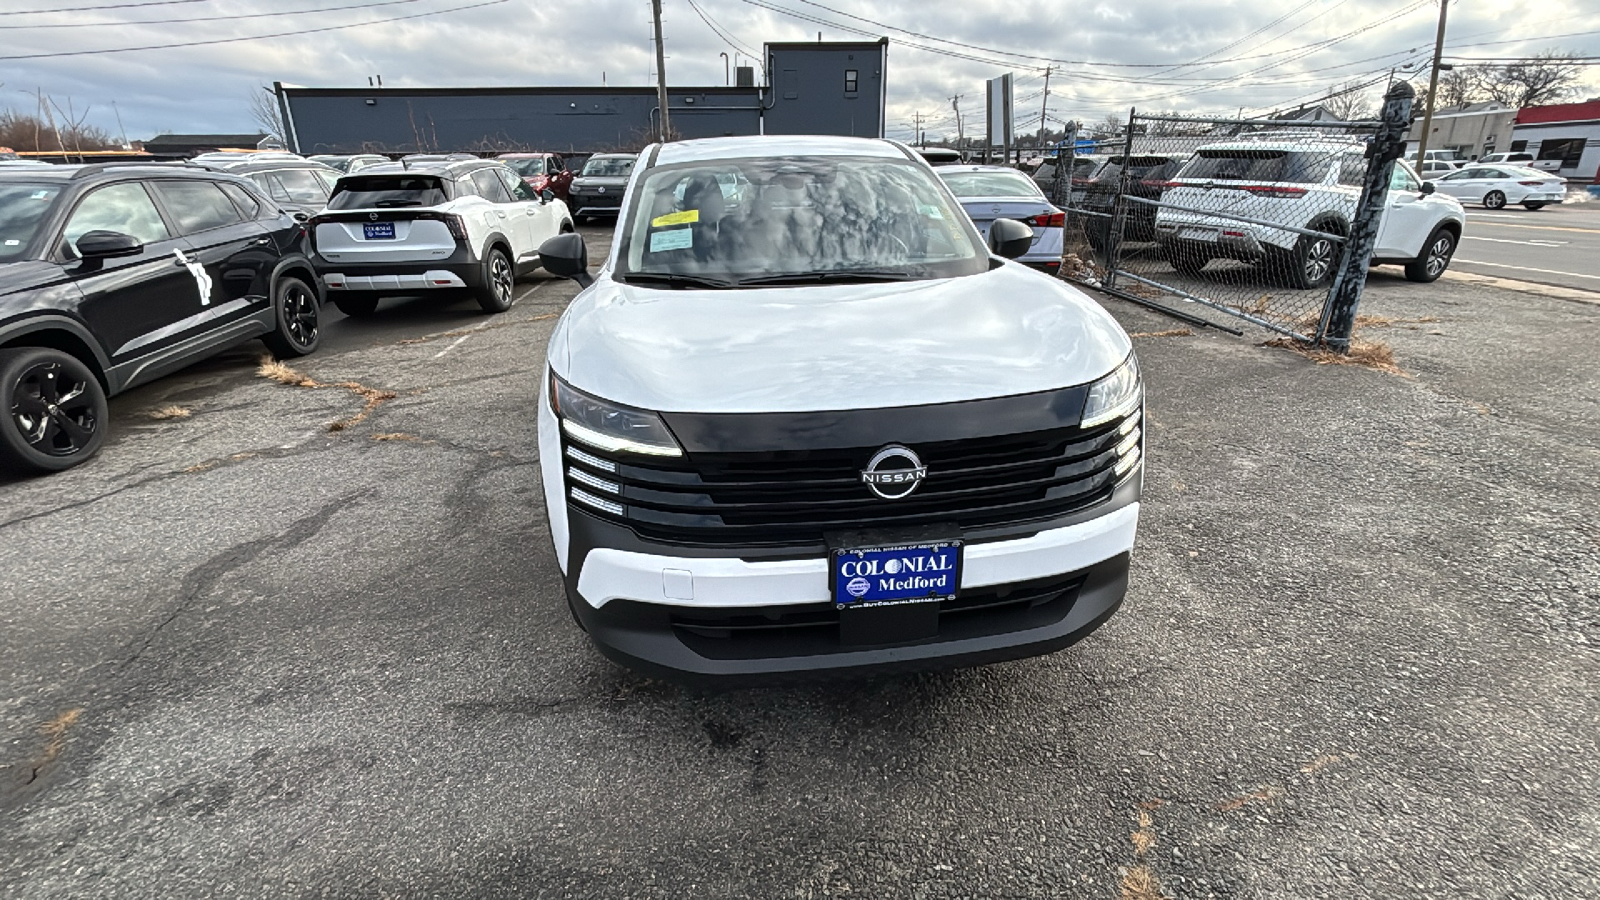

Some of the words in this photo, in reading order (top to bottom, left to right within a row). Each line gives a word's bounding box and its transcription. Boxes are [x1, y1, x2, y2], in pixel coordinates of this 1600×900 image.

[862, 469, 926, 483] NISSAN
[841, 554, 953, 578] COLONIAL
[878, 575, 947, 592] Medford
